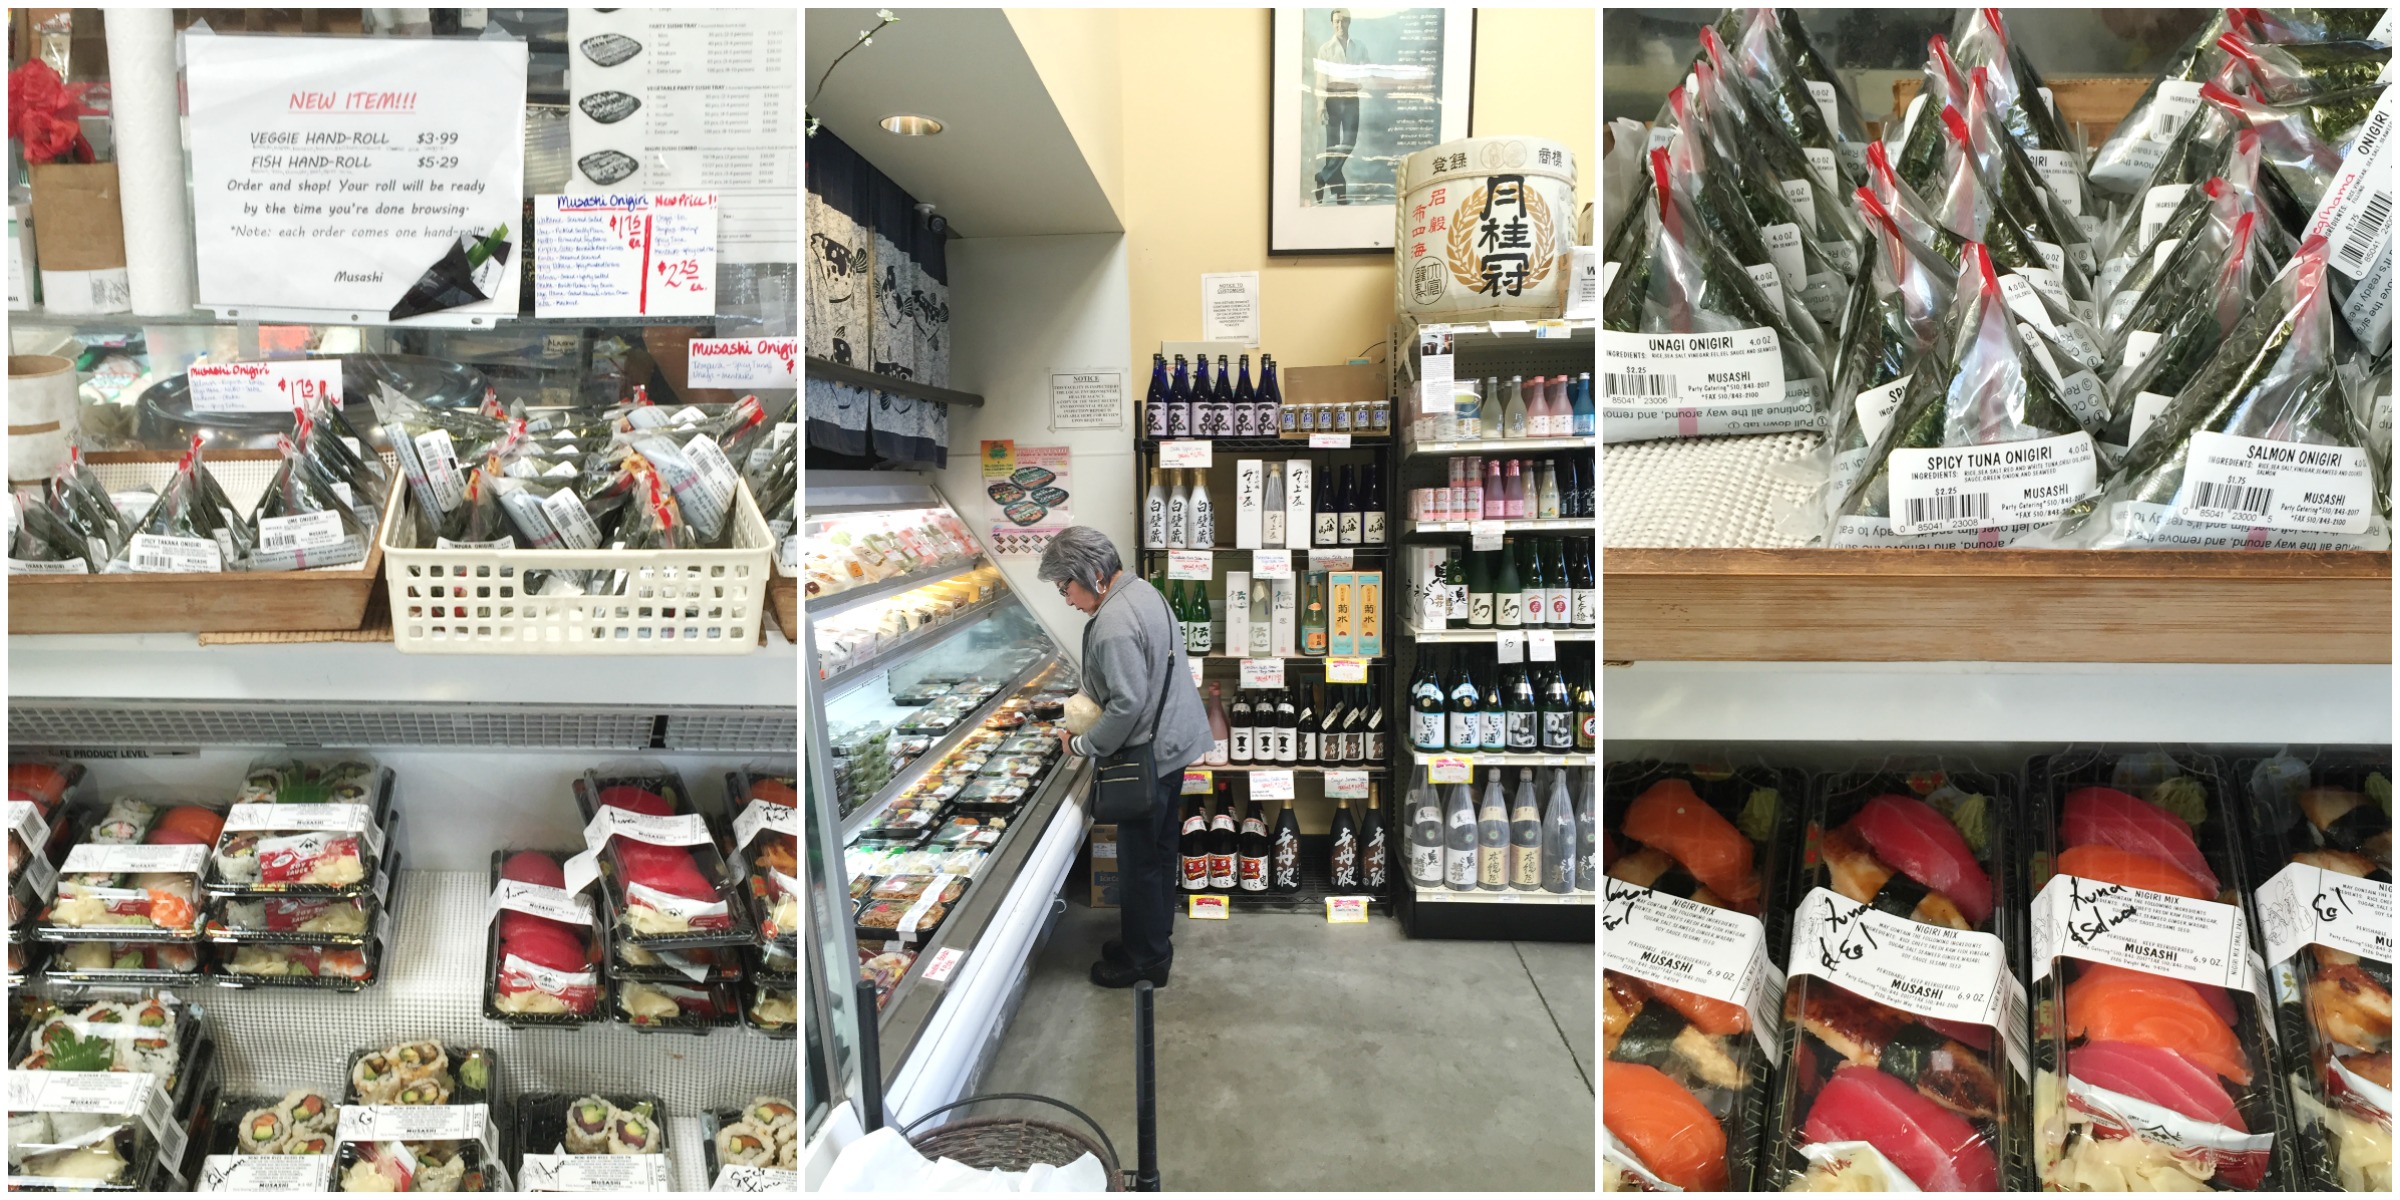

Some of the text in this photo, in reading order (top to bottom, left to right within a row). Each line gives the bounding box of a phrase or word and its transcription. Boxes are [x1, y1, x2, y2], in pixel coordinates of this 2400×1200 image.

[289, 92, 417, 110] NEW ITEM!!!
[250, 132, 459, 145] VEGGIE HAND-ROLL $3.99
[2357, 110, 2390, 156] ONIGIRI
[251, 156, 459, 169] FISH HAND-ROLL $5.29
[227, 179, 486, 195] Order and shop! Your roll will be ready
[558, 194, 649, 212] Musashi Onigiri
[655, 195, 677, 208] New
[243, 203, 259, 217] by
[265, 203, 286, 215] the
[292, 203, 323, 215] time
[328, 203, 369, 217] you're
[375, 203, 405, 215] done
[2346, 212, 2361, 232] $1.75
[278, 225, 306, 238] each
[312, 225, 346, 238] order
[351, 227, 390, 238] comes
[396, 228, 417, 238] one
[1478, 174, 1532, 297] 月桂冠
[1773, 231, 1794, 242] 4.0 OZ
[2364, 240, 2381, 264] 85041
[334, 271, 384, 284] Musashi
[2008, 282, 2026, 292] 4.0 OZ
[692, 341, 752, 357] Musashi
[1648, 336, 1772, 352] UNAGI ONIGIRI 4.0 OZ
[1606, 350, 1647, 359] INGREDIENTS:
[190, 363, 270, 380] Musashi Onigiri
[1626, 366, 1647, 374] $2.25
[1708, 371, 1751, 383] MUSASHI
[1688, 385, 1704, 393] Party
[1612, 396, 1684, 404] 85041 23006 7
[1637, 403, 1813, 420] Continue all the way around, and
[1742, 418, 1814, 428] Pull down tab
[1927, 442, 2089, 470] SPICY TUNA ONIGIRI 4.0 OZ
[2208, 455, 2254, 469] INGREDIENTS:
[2246, 444, 2342, 468] SALMON ONIGIRI
[1911, 470, 1959, 481] INGREDIENTS:
[2002, 468, 2057, 480] ONION SEAWEED
[2227, 476, 2246, 484] $1.75
[2256, 470, 2276, 478] SALMON
[1934, 486, 1957, 496] $2.25
[2024, 483, 2069, 500] MUSASHI
[2303, 491, 2346, 506] MUSASHI
[2280, 503, 2294, 512] Party
[2200, 508, 2273, 524] 85041 23000 5
[1917, 518, 1979, 532] 85041 23008
[2158, 534, 2274, 550] around, and remove
[1336, 603, 1349, 623] 菊水
[1364, 603, 1375, 623] 菊水
[74, 750, 150, 759] PRODUCT LEVEL
[1275, 826, 1298, 888] 辛丹波
[1334, 826, 1358, 888] 辛丹波
[2135, 890, 2180, 904] NIGIRI MIX
[1672, 898, 1716, 916] NIGIRI MIX
[1914, 924, 1958, 940] NIGIRI MIX
[2234, 930, 2242, 948] SMALL
[2124, 942, 2178, 962] MUSASHI
[1640, 951, 1694, 973] MUSASHI
[2193, 954, 2224, 968] 6.9 OZ.
[1706, 968, 1736, 982] 6.9 OZ.
[1890, 978, 1944, 1000] MUSASHI
[1957, 992, 1985, 1002] 6.9 OZ.
